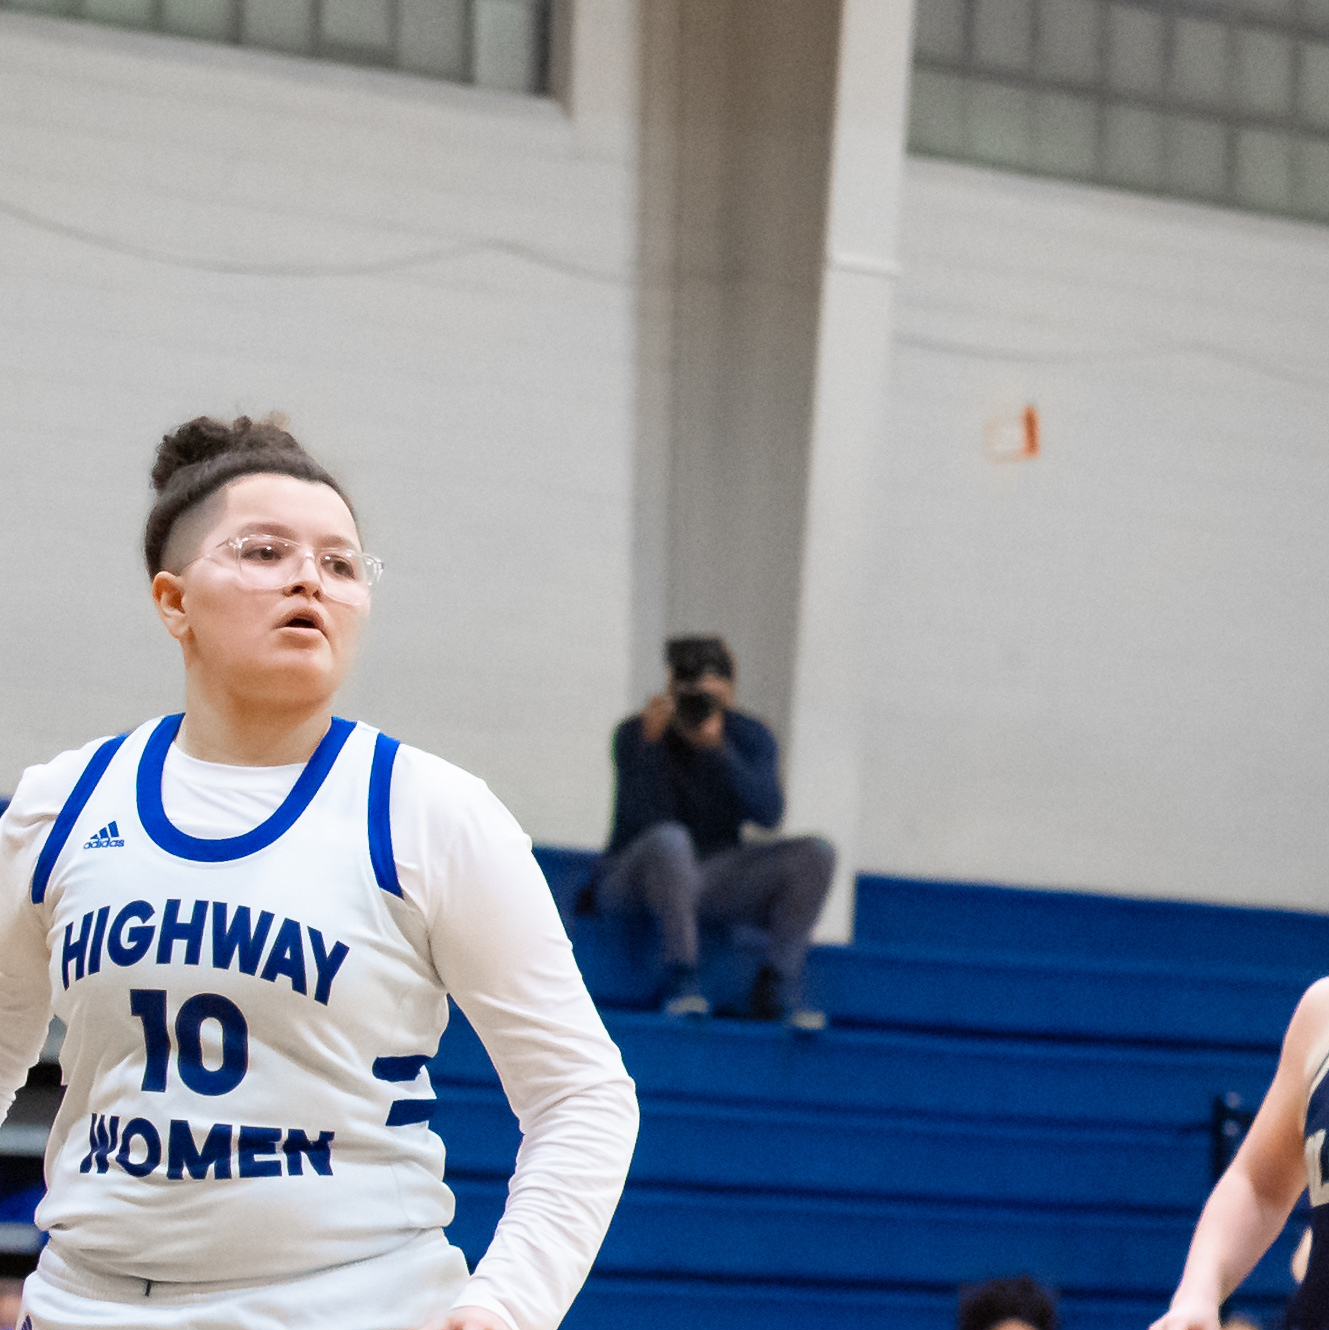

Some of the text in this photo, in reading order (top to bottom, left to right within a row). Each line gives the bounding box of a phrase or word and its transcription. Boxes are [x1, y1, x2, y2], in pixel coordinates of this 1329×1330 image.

[83, 837, 124, 850] adidas
[62, 899, 350, 1006] HIGHWAY
[130, 989, 249, 1096] 10
[80, 1113, 335, 1180] WOMEN
